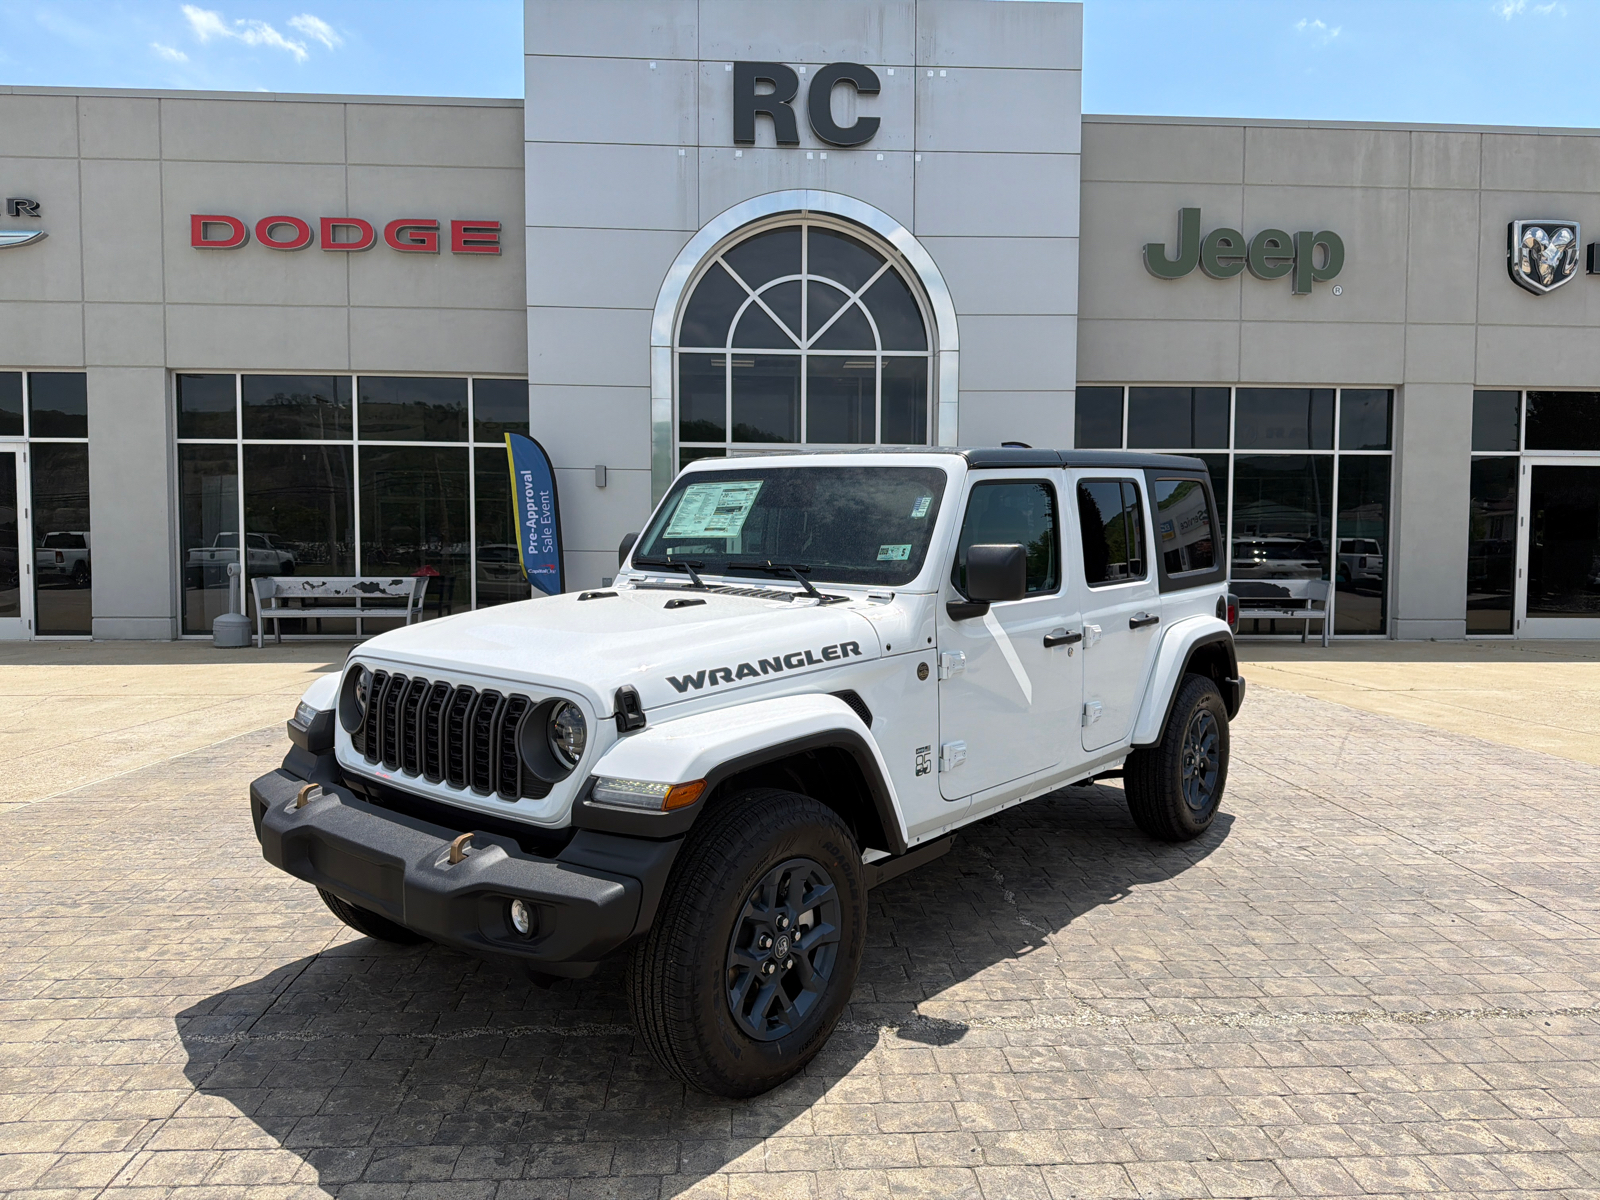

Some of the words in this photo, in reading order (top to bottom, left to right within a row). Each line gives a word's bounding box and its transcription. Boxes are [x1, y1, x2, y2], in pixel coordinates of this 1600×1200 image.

[733, 62, 881, 148] RC
[190, 214, 502, 255] DODGE
[1143, 207, 1345, 295] Jeep
[520, 470, 539, 554] Pre-Approval
[539, 490, 552, 524] Event
[541, 528, 553, 553] Sale
[666, 641, 863, 694] WRANGLER
